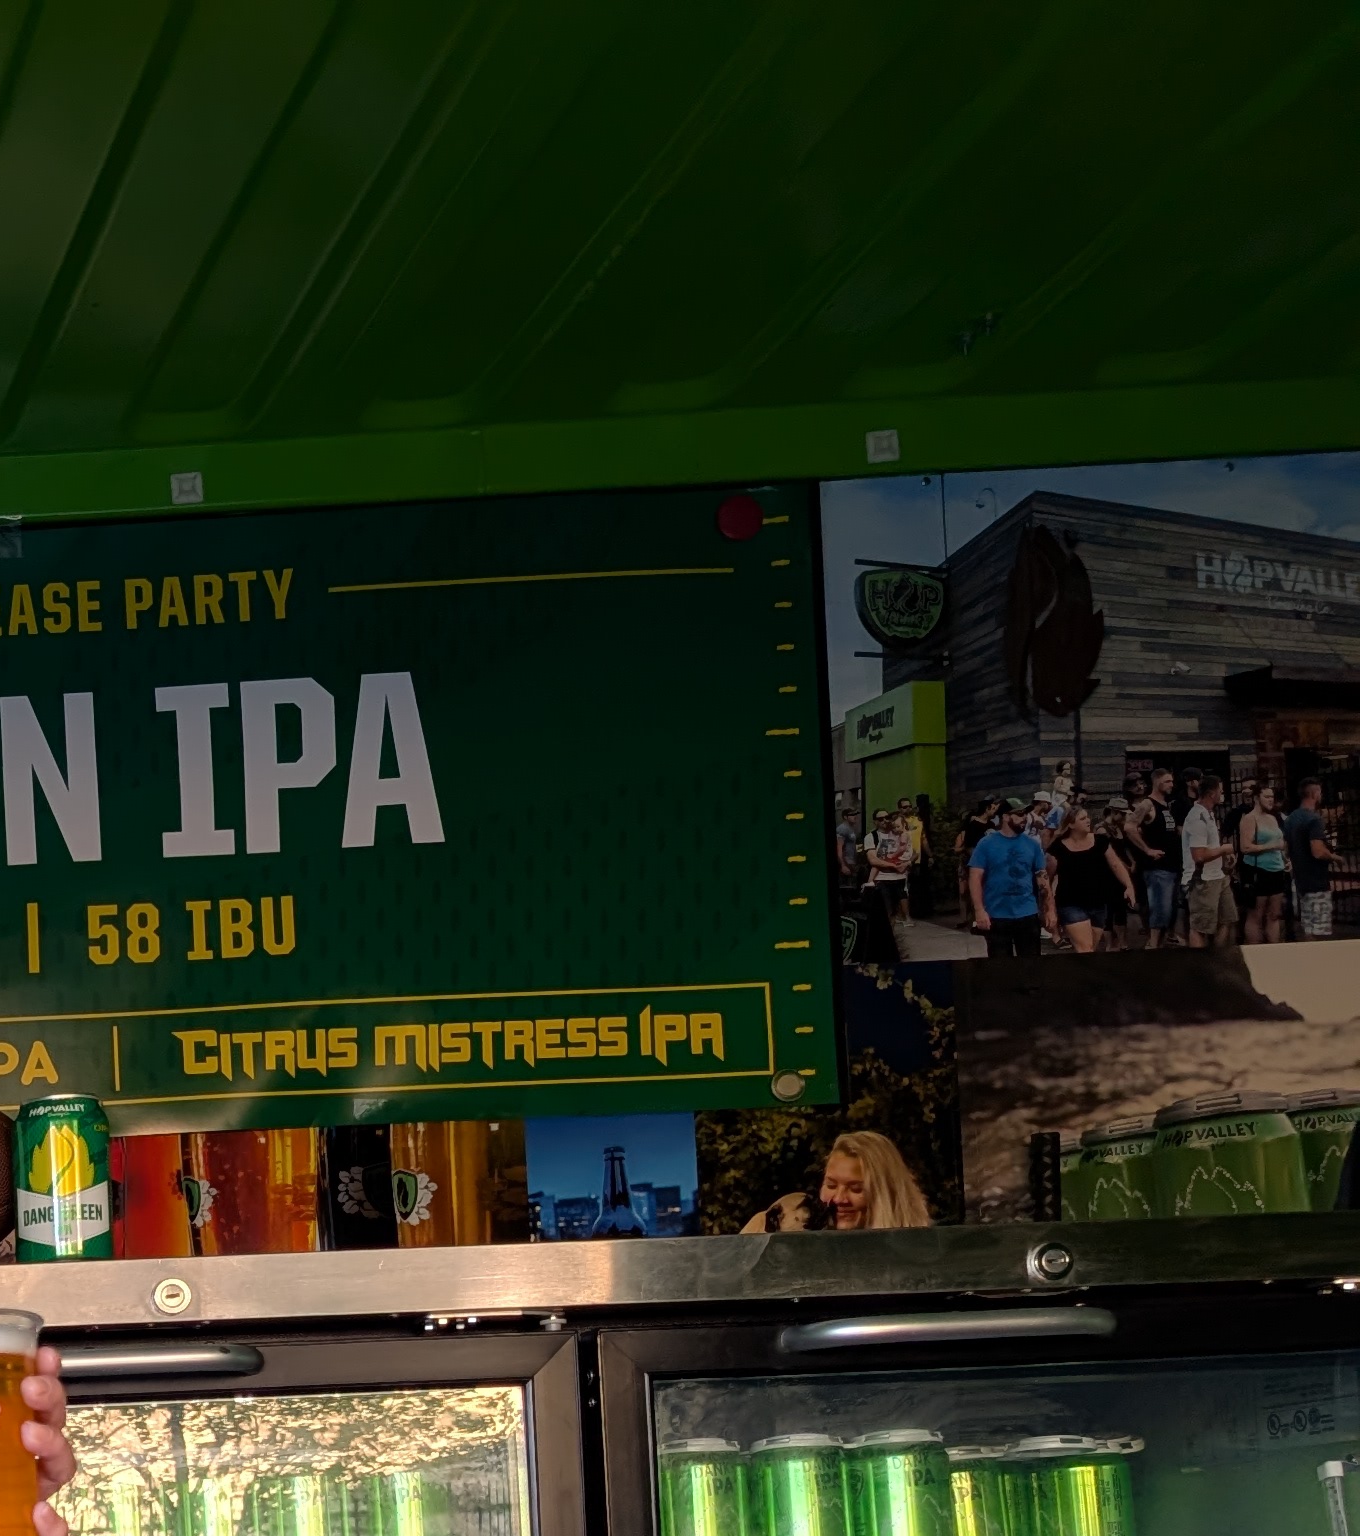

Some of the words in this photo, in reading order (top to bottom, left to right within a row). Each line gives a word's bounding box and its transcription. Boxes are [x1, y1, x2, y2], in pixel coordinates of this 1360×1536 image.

[123, 568, 294, 630] PARTY
[155, 671, 446, 858] IPA
[86, 902, 161, 966] 58
[185, 895, 296, 962] IBU
[172, 1027, 358, 1081] CITRUS
[374, 1016, 628, 1073] MISTRESS
[639, 1004, 724, 1067] IPA
